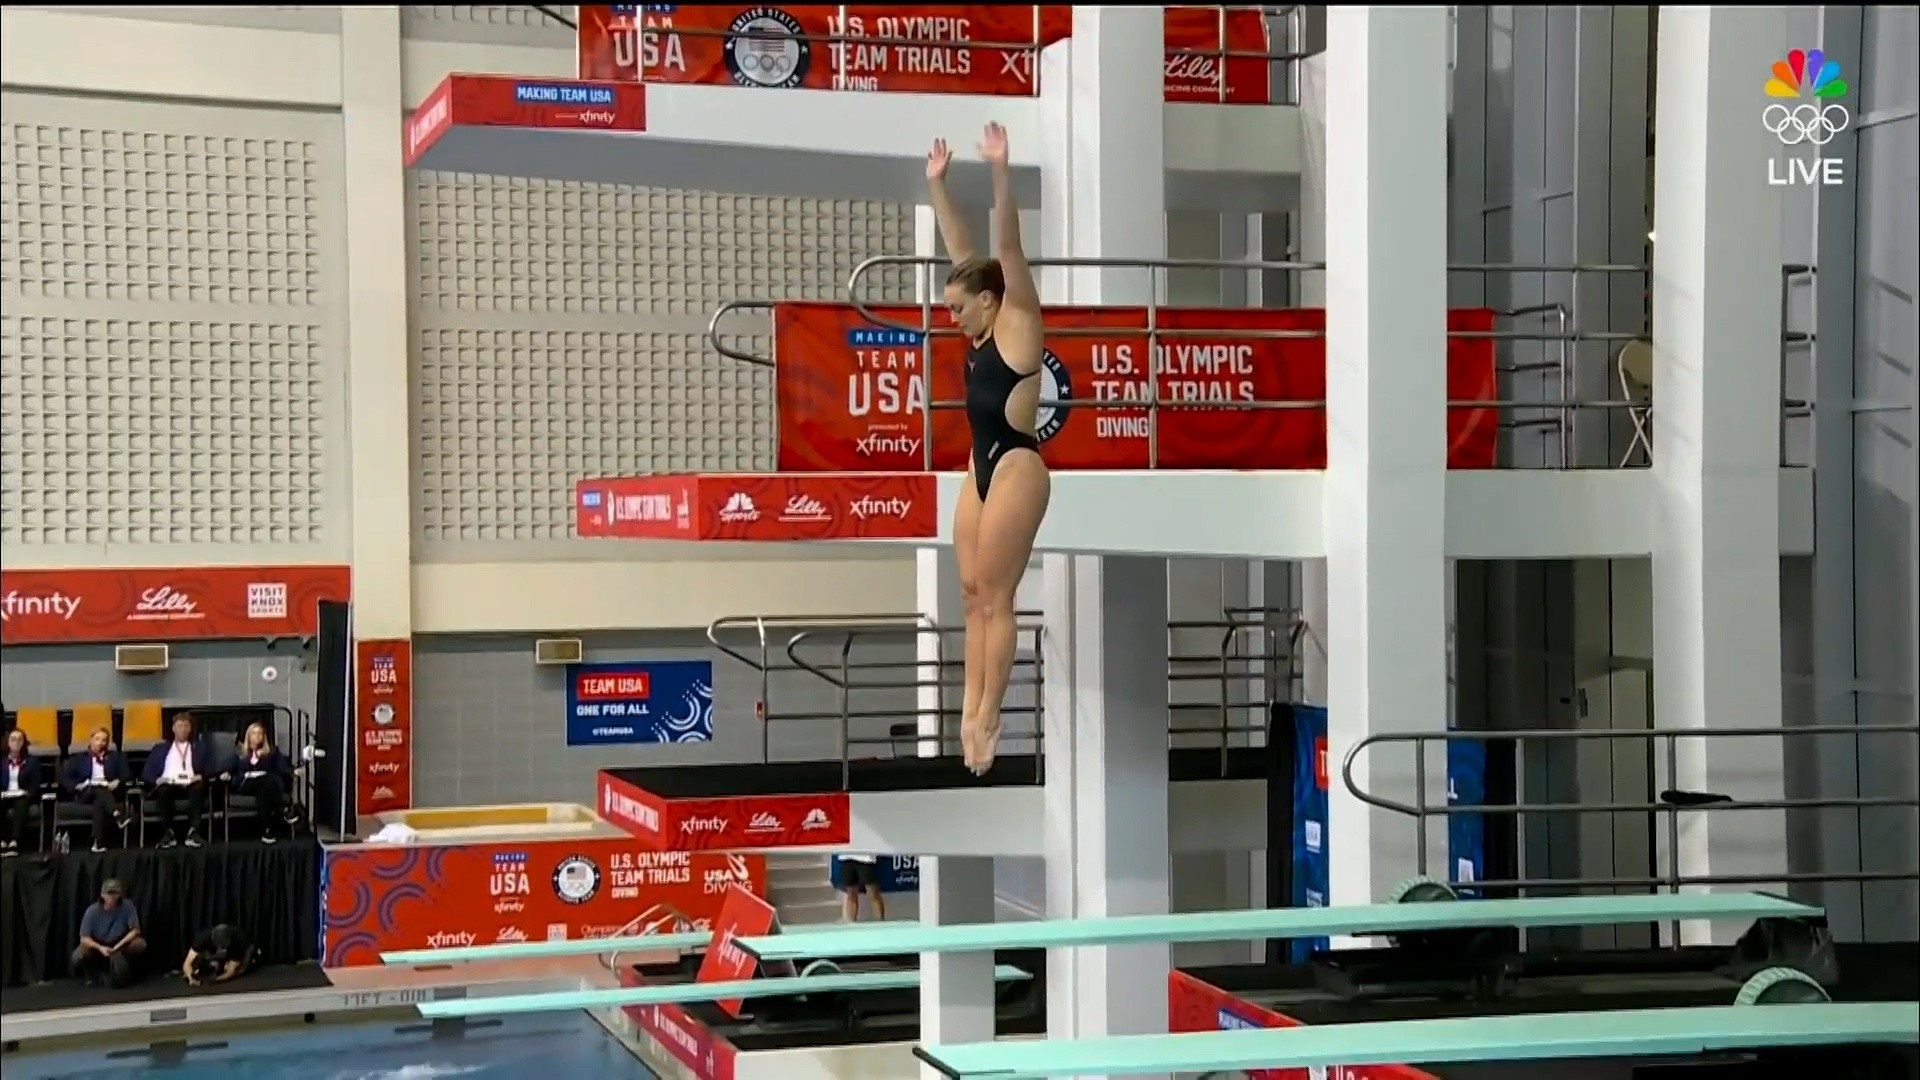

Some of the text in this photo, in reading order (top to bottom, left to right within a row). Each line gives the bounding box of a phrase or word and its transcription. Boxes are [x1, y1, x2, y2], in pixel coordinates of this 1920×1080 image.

[827, 15, 971, 42] U.S. OLYMPIC
[613, 32, 686, 73] USA
[895, 46, 971, 75] TRIALS
[832, 75, 878, 91] DVING
[517, 86, 612, 103] MAKING TEAM USA
[579, 110, 616, 124] xfinity
[856, 332, 917, 344] MAKING
[857, 350, 917, 369] TEAM
[1092, 345, 1253, 375] U.S. OLYMPIC
[849, 371, 925, 417] USA
[1168, 381, 1255, 410] TRIALS
[1096, 417, 1149, 438] DIVING
[856, 432, 920, 457] xfinity
[850, 494, 911, 519] xfinity
[136, 585, 197, 614] Lilly
[251, 587, 283, 596] VISIT
[251, 597, 283, 606] KNOX
[371, 669, 397, 684] USA
[583, 678, 643, 694] TEAM USA
[576, 703, 649, 717] ONE FOR ALL
[681, 815, 729, 835] xfinity
[610, 853, 634, 869] U.S.
[638, 850, 691, 868] OLYMPIC
[490, 872, 530, 896] USA
[610, 867, 691, 886] TEAM TRIALS
[704, 869, 735, 882] USA
[704, 879, 753, 895] DIVG
[426, 930, 477, 949] xfinity
